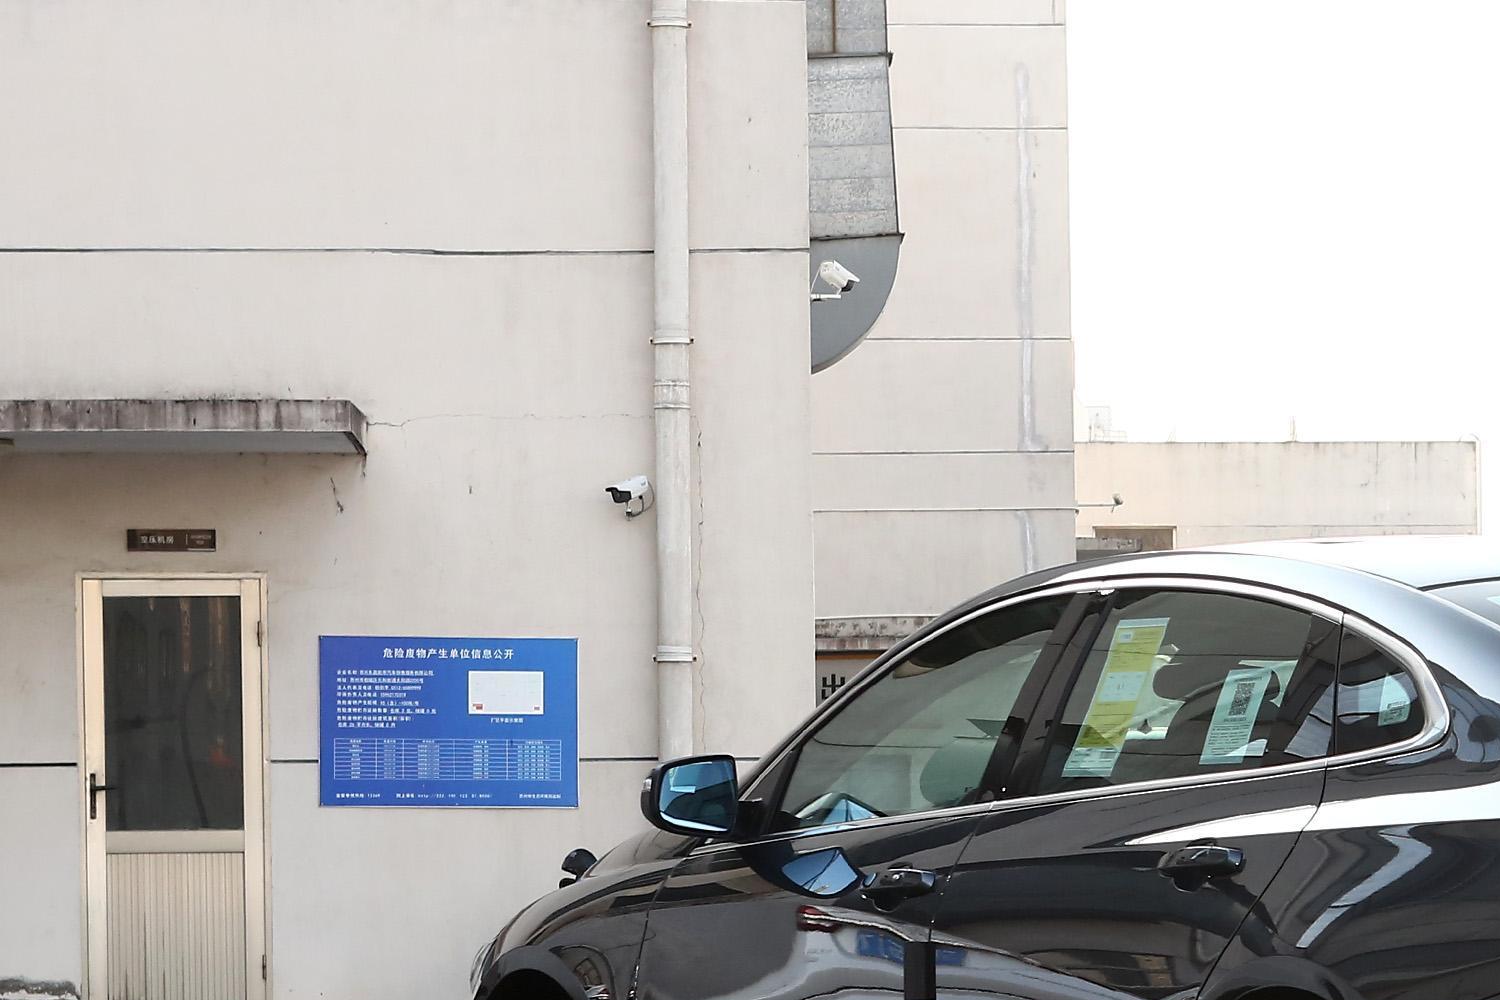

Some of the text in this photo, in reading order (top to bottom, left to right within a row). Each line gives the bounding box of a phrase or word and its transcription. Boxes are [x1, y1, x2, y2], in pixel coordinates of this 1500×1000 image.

[383, 647, 514, 659] 危险废物产生单位信息公开
